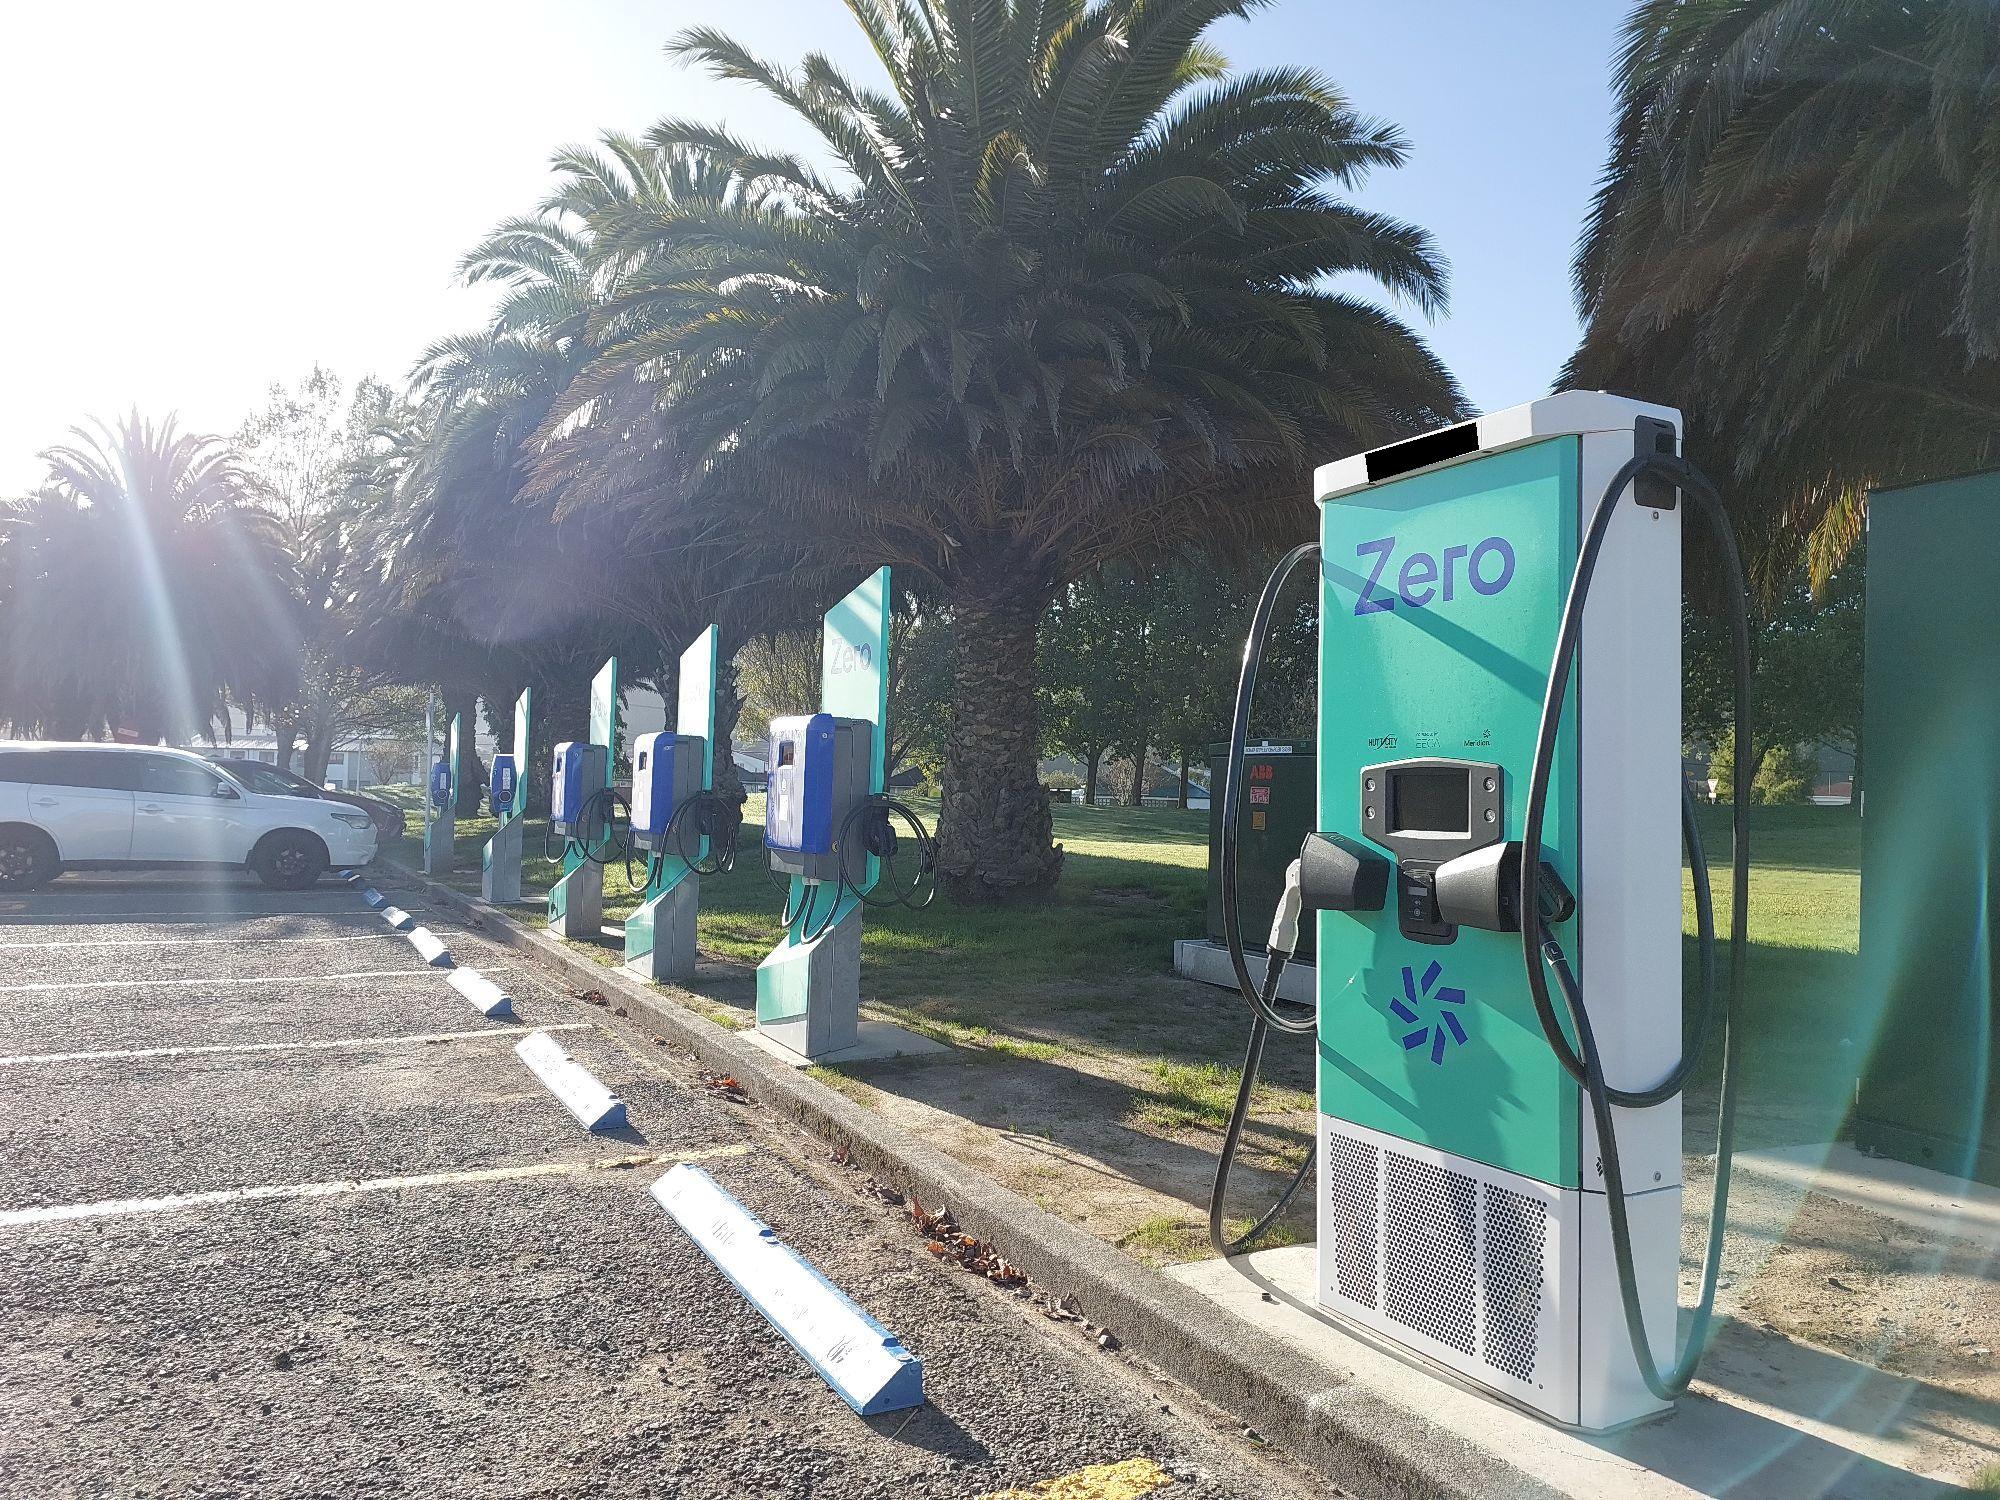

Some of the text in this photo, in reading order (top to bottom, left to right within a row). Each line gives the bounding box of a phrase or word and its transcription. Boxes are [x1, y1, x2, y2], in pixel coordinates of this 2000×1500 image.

[1354, 536, 1516, 616] Zero
[831, 637, 871, 674] Zero
[1463, 739, 1491, 747] Meridian
[1250, 765, 1273, 780] ABB
